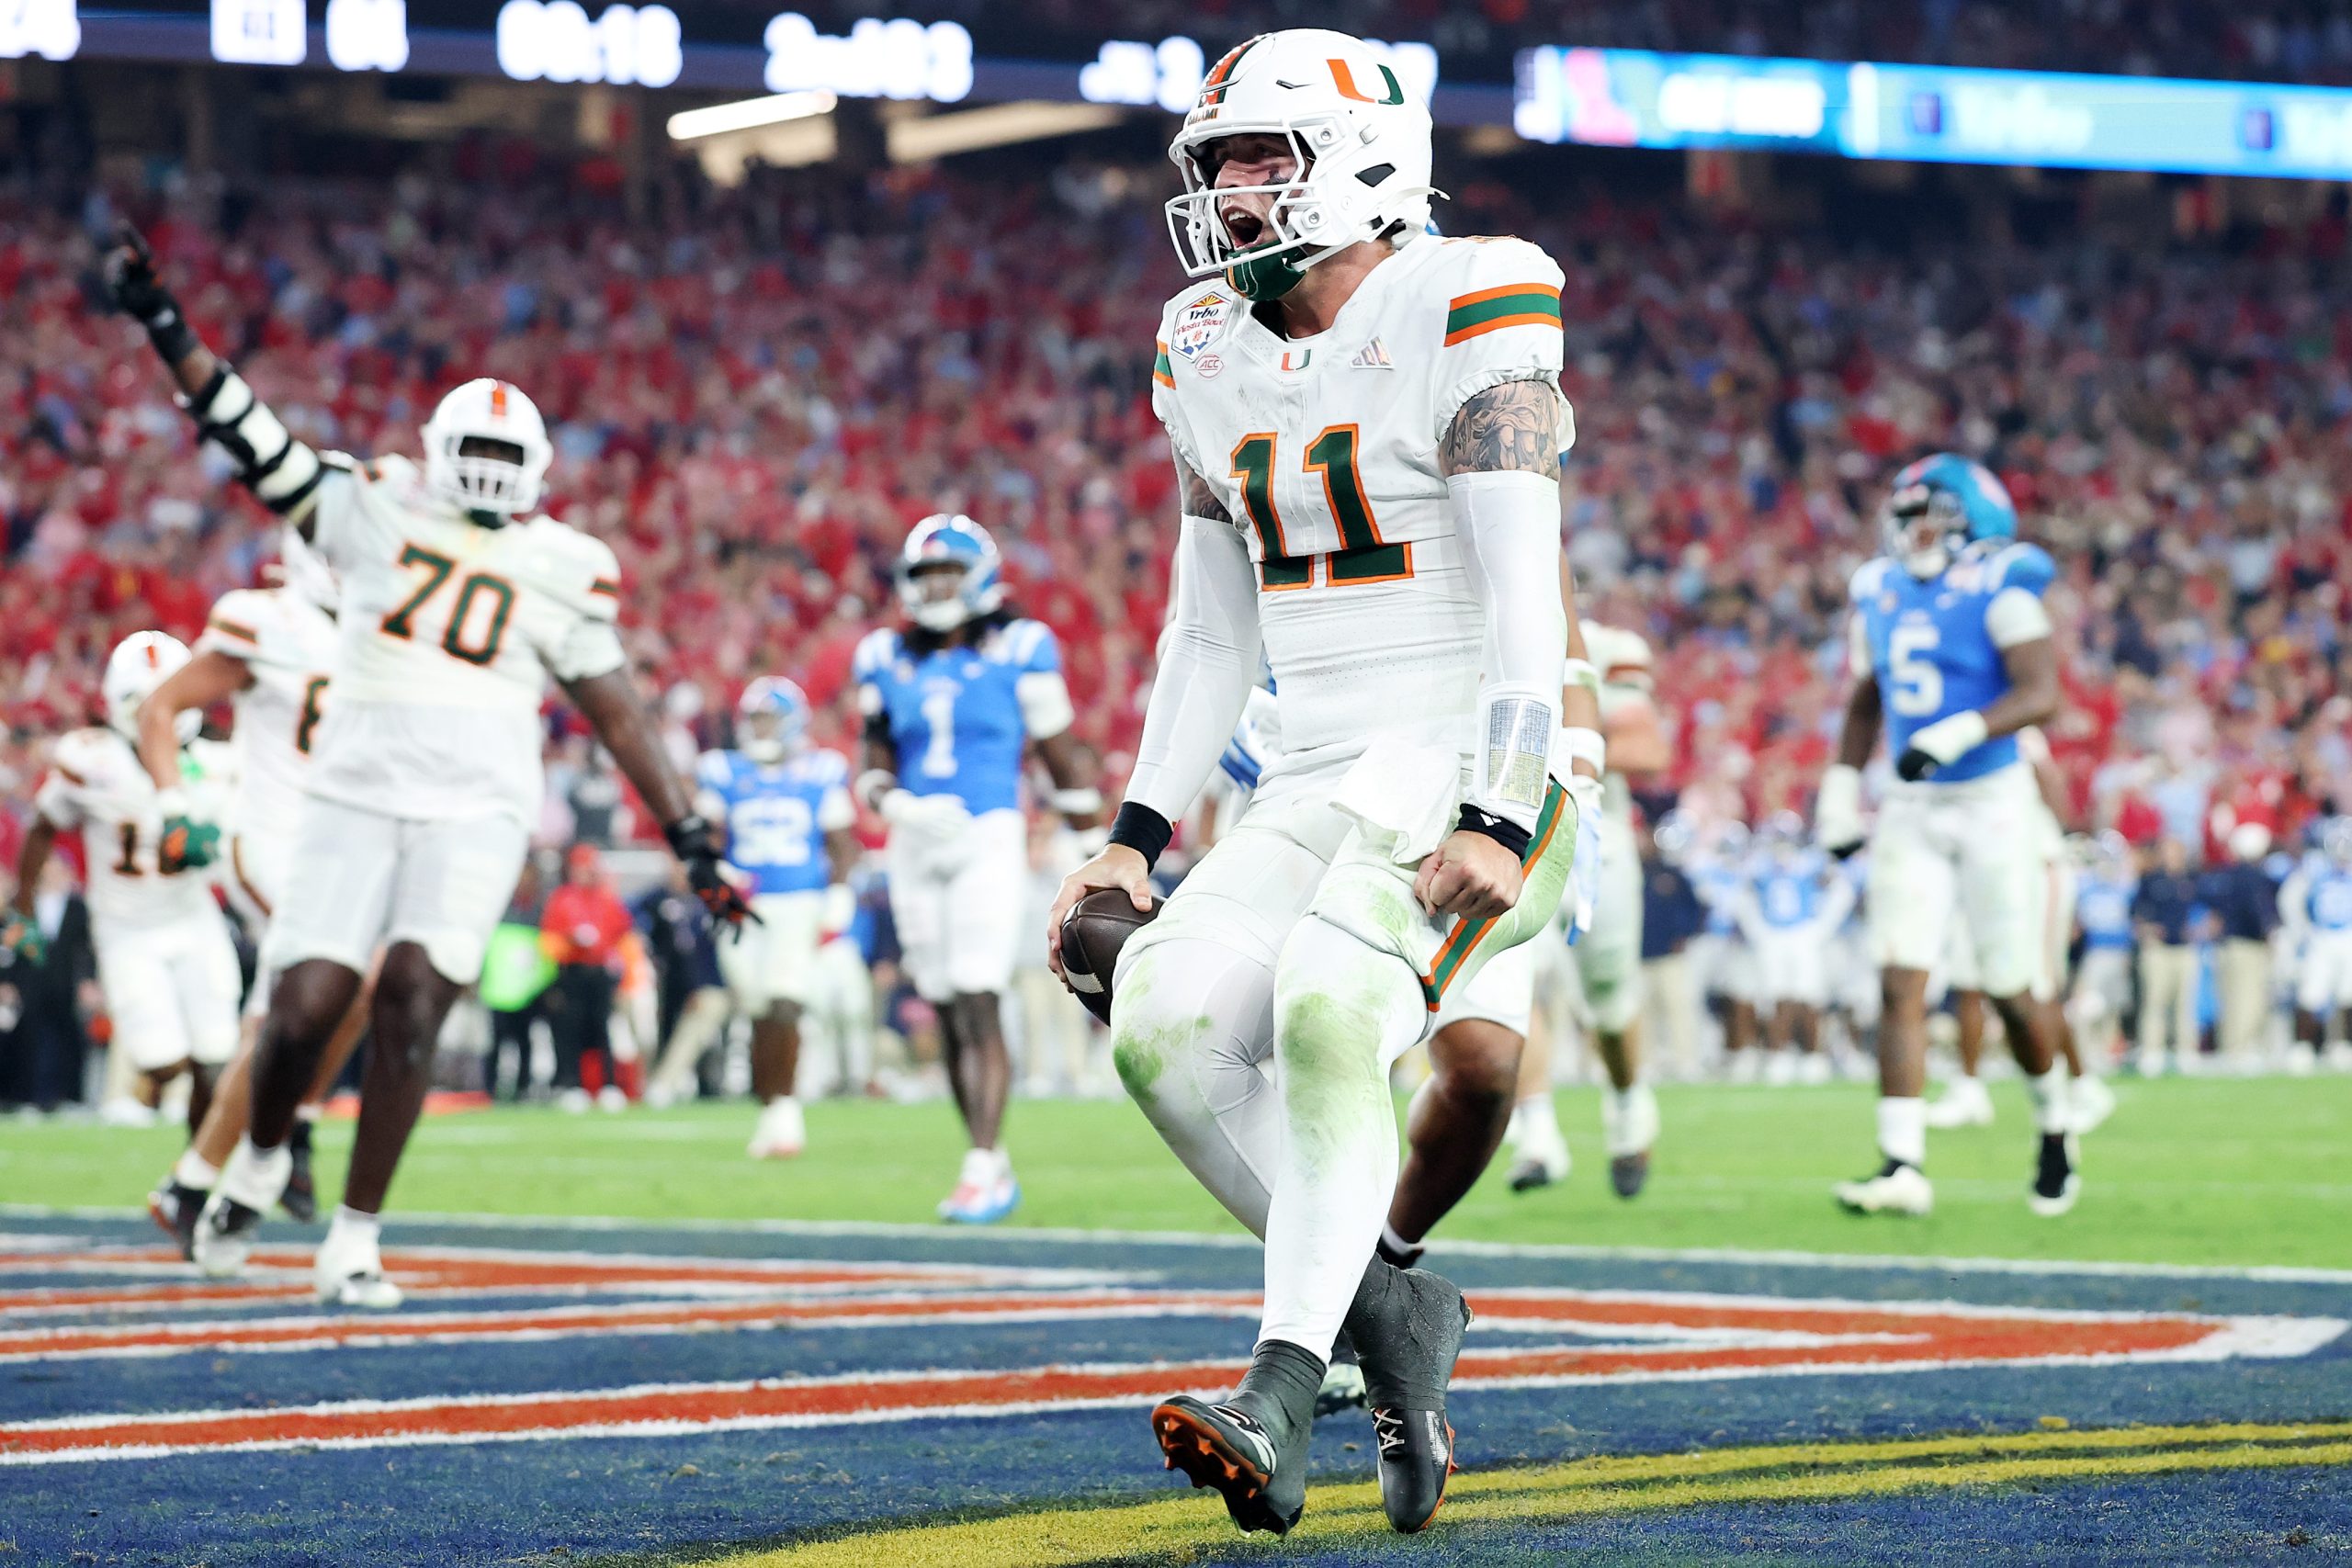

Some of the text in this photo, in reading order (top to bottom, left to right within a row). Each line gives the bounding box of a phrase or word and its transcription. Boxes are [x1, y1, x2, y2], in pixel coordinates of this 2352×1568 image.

[1326, 59, 1404, 105] U
[1176, 318, 1226, 336] Fiesta Bowl
[1190, 307, 1219, 321] Vrbo
[1199, 359, 1220, 368] ACC
[1281, 348, 1312, 370] U
[1228, 423, 1415, 592] 11
[379, 540, 515, 666] 70
[1890, 625, 1944, 717] 5
[921, 693, 958, 779] 1
